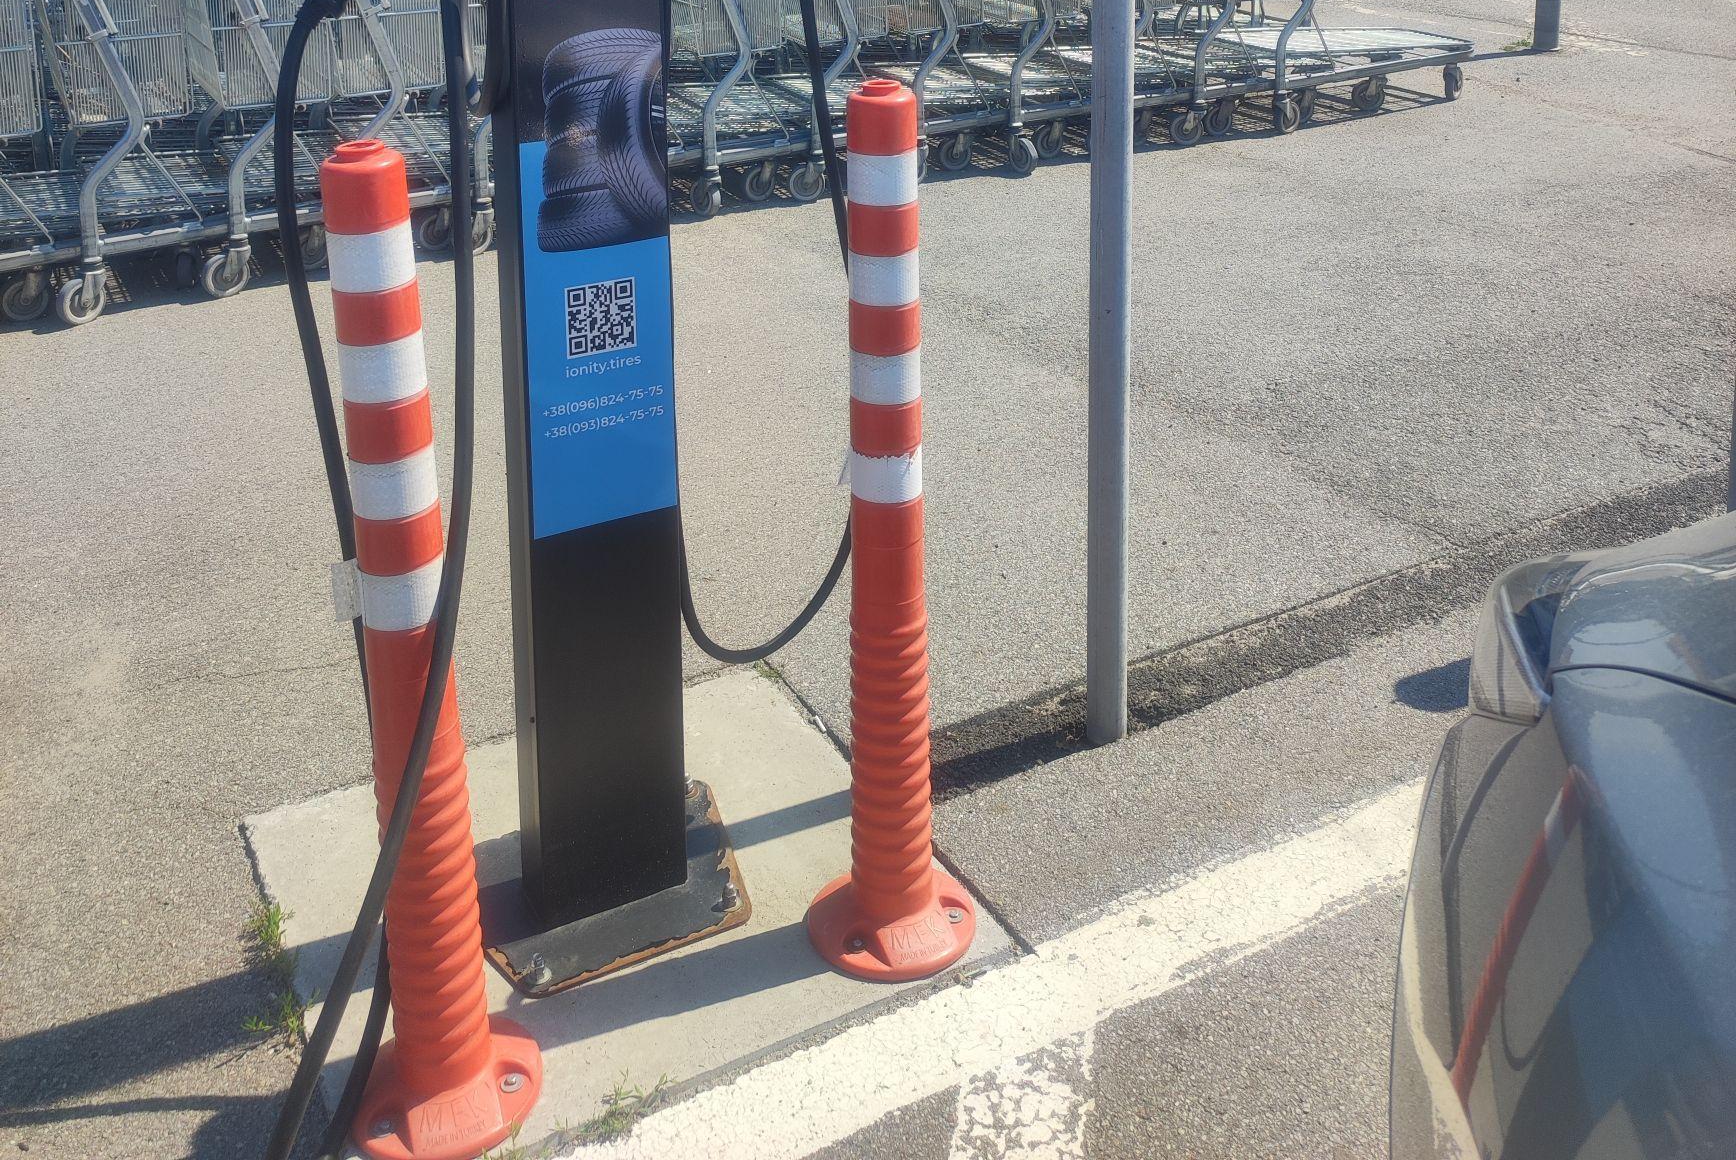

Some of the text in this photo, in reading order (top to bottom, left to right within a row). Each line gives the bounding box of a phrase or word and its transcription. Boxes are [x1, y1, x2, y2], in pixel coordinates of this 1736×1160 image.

[565, 355, 642, 378] ionity.tires
[542, 385, 664, 417] +38(096)824-75-75
[544, 406, 664, 438] +38(093)824-75-75
